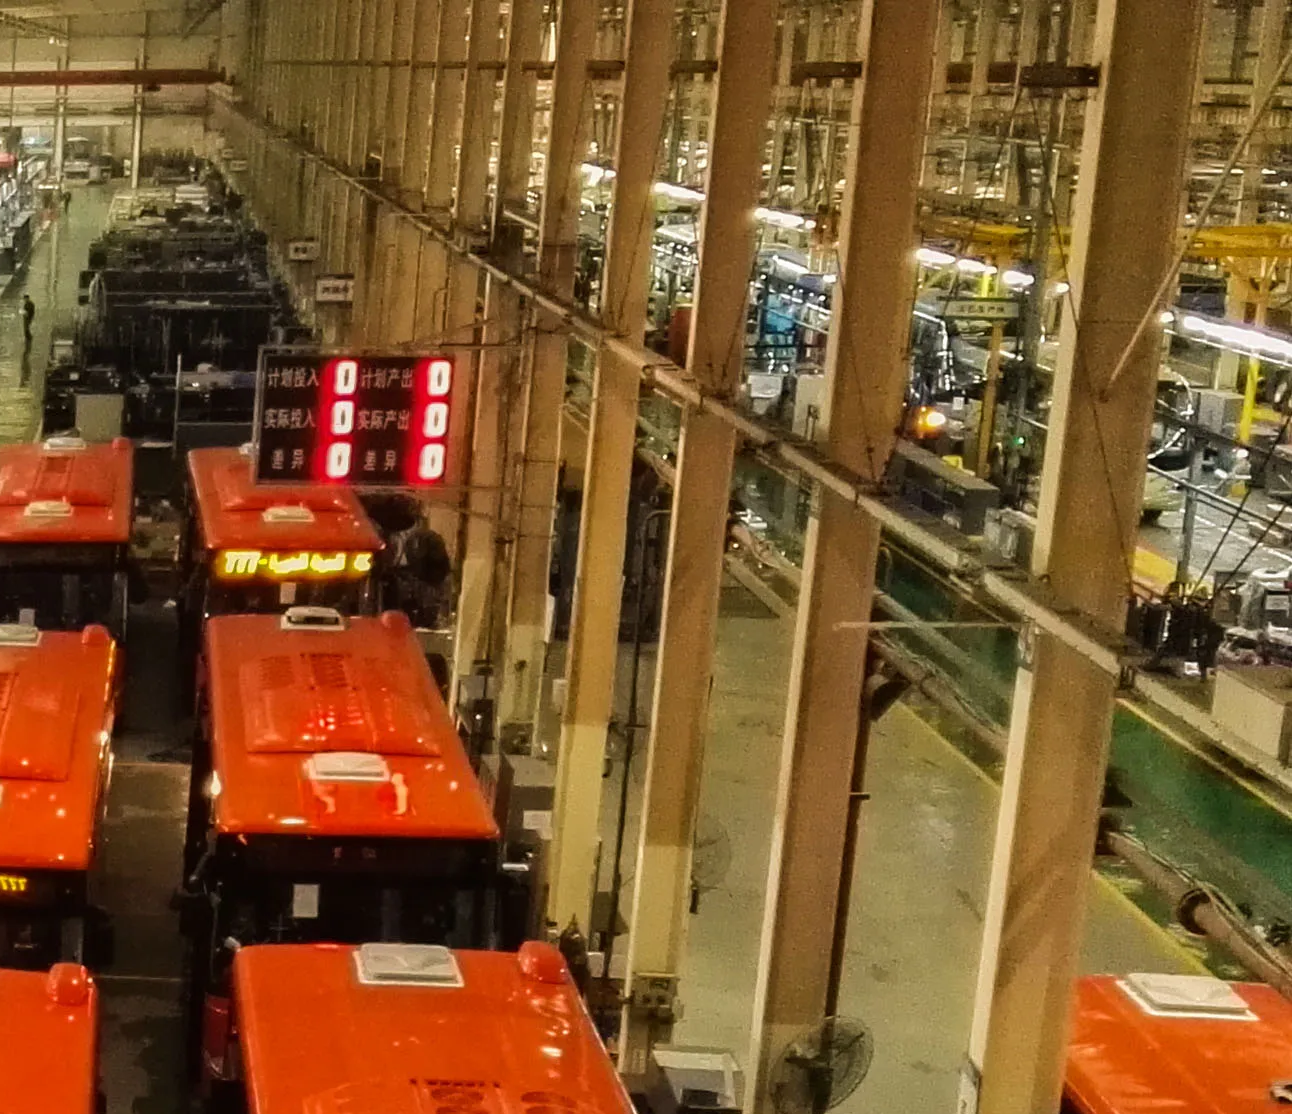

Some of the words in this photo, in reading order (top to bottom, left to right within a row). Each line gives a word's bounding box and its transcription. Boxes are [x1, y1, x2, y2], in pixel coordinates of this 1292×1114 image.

[267, 368, 319, 388] 计划投入
[334, 360, 358, 396] 0
[361, 368, 414, 389] 计划产出
[427, 360, 452, 397] 0
[264, 408, 316, 429] 实际投入
[331, 400, 355, 436] 0
[357, 409, 410, 431] 实际产出
[422, 403, 449, 438] 0
[326, 442, 352, 479] 0
[418, 443, 446, 480] 0
